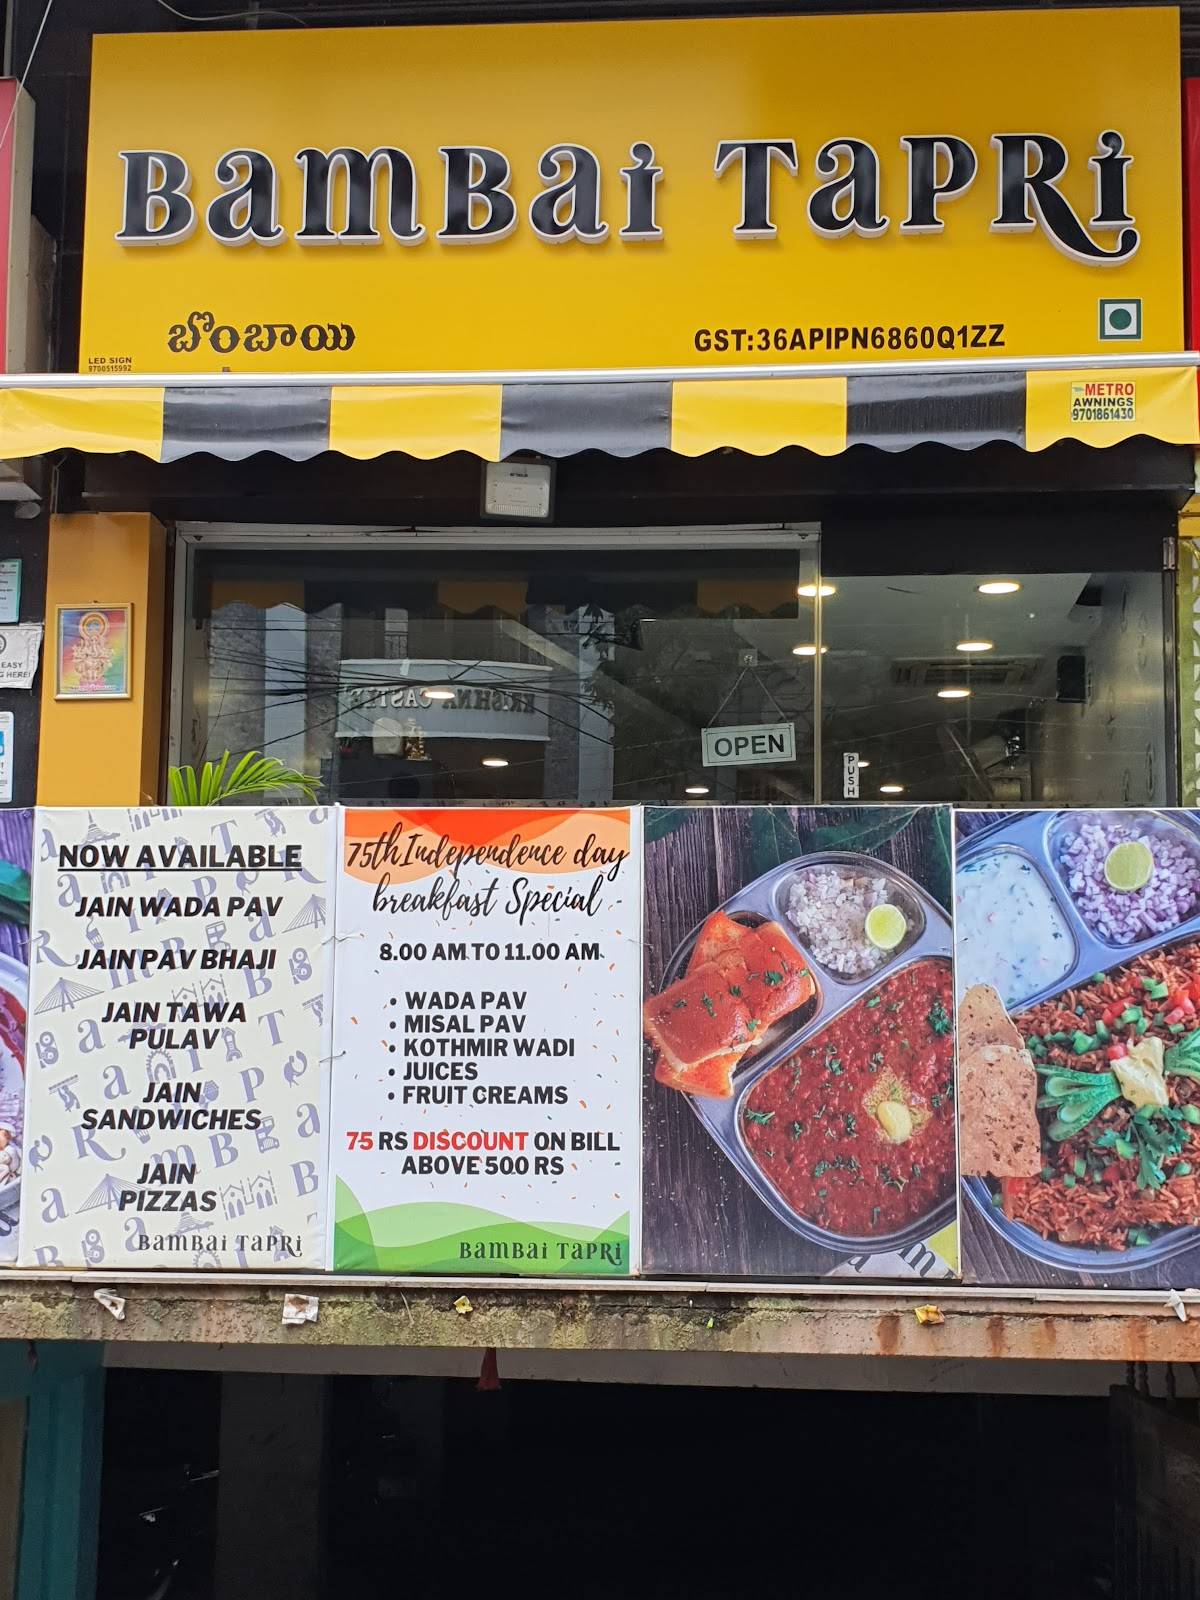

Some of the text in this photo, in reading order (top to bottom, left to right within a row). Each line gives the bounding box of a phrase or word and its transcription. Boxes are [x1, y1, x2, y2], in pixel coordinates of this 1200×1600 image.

[1085, 383, 1134, 396] METRO
[1073, 397, 1134, 408] AWNINGS
[1072, 407, 1134, 420] 9701861430
[1, 661, 23, 669] EASY
[714, 734, 785, 757] OPEN
[847, 755, 855, 795] PUSH
[60, 845, 301, 867] NOW AVAILABLE
[347, 822, 628, 881] 75th Independence day
[76, 897, 282, 916] JAIN WADA PAV
[373, 874, 603, 925] breakfast Special
[78, 950, 276, 969] JAIN PAV BHAJI
[380, 943, 599, 960] 8.00 AM TO 11.00 AM
[406, 992, 526, 1009] WADA PAV
[102, 1003, 245, 1022] JAIN TAWA
[405, 1015, 525, 1032] MISAL PAV
[130, 1029, 219, 1049] PULAV
[405, 1039, 574, 1056] KOTHMIR WADI
[404, 1062, 477, 1080] JUICES
[143, 1083, 201, 1102] JAIN
[404, 1086, 567, 1104] FRUIT CREAMS
[81, 1109, 261, 1129] SANDWICHES
[347, 1131, 619, 1151] 75 RS DISCOUNT ON BILL
[137, 1164, 195, 1184] JAIN
[402, 1156, 563, 1175] ABOVE 500 RS
[119, 1191, 216, 1211] PIZZAS
